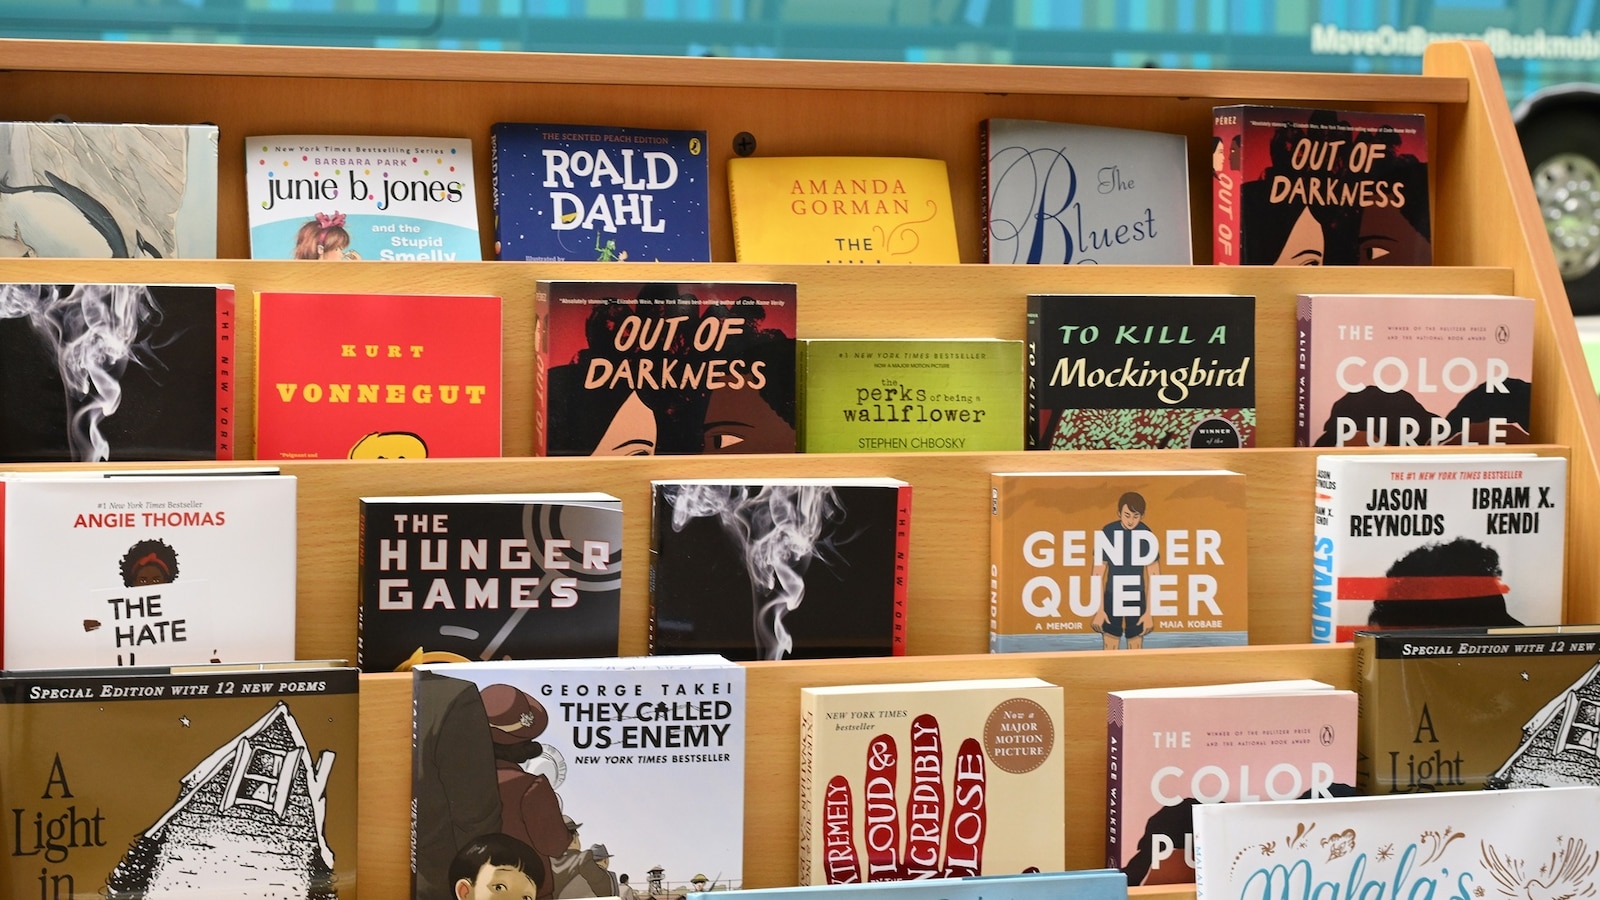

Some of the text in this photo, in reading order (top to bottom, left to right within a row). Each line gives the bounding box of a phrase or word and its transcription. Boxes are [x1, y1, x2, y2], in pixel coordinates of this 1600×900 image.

[1215, 116, 1237, 126] PÉREZ
[542, 132, 669, 145] THE SCENTED PEACH EDITION
[315, 158, 407, 167] BARBARA PARK
[356, 147, 410, 155] Bestselling
[1291, 138, 1386, 174] OUT OF
[542, 149, 679, 191] ROALD
[1097, 165, 1135, 194] The
[262, 171, 338, 210] junie
[790, 179, 907, 195] AMANDA
[1269, 175, 1406, 208] DARKNESS
[550, 192, 666, 233] DAHL
[791, 200, 909, 215] GORMAN
[990, 147, 1157, 264] Bluest
[1218, 173, 1233, 257] OUT OF
[372, 224, 420, 233] and the
[391, 237, 443, 249] Stupid
[834, 238, 873, 251] THE
[380, 249, 456, 261] Smelly
[614, 315, 746, 352] OUT OF
[1058, 325, 1227, 345] TO KILL A
[1338, 325, 1374, 341] THE
[341, 345, 424, 358] KURT
[1029, 342, 1036, 367] TO
[220, 310, 229, 451] THE NEW YORK
[584, 358, 767, 391] DARKNESS
[881, 379, 898, 387] the
[1049, 357, 1250, 405] Mockingbird
[1335, 356, 1511, 394] COLOR
[276, 383, 486, 404] VONNEGUT
[856, 384, 927, 405] perks
[930, 394, 942, 402] of
[943, 394, 973, 404] being
[843, 405, 986, 423] wallflower
[1337, 416, 1508, 447] PURPLE
[858, 438, 966, 449] STEPHEN CHBOSKY
[1391, 470, 1523, 480] THE #1 NEW YORK TIMES BESTSELLER
[97, 502, 107, 510] #1
[127, 501, 143, 509] York
[145, 501, 166, 509] Times
[167, 500, 203, 509] Bestseller
[1366, 488, 1428, 511] JASON
[1472, 486, 1555, 510] IBRAM X.
[73, 511, 226, 528] ANGIE THOMAS
[394, 514, 449, 534] THE
[1350, 514, 1445, 537] REYNOLDS
[1487, 512, 1539, 535] KENDI
[379, 539, 610, 571] HUNGER
[1022, 529, 1225, 569] GENDER
[895, 508, 906, 643] THE NEW YORK
[378, 577, 579, 611] GAMES
[1021, 574, 1224, 618] QUEER
[1312, 536, 1334, 644] STAMP
[107, 595, 162, 620] THE
[990, 564, 998, 643] GENDER
[115, 619, 187, 648] HATE
[1035, 621, 1083, 631] A MEMOIR
[1159, 620, 1223, 629] MAIA KOBABE
[1549, 641, 1565, 652] 12
[215, 681, 235, 695] 12
[540, 682, 732, 697] GEORGE TAKEI
[559, 700, 732, 723] THEY CALLED
[825, 710, 908, 720] NEW YORK TIMES
[1003, 710, 1025, 720] Now
[1413, 701, 1439, 744] A
[572, 723, 731, 749] US ENEMY
[835, 723, 875, 732] bestseller
[1000, 722, 1038, 733] MAJOR
[995, 734, 1043, 745] MOTION
[1153, 731, 1191, 748] THE
[575, 753, 730, 765] NEW YORK TIMES BESTSELLER
[868, 741, 896, 771] &
[994, 746, 1044, 757] PICTURE
[41, 752, 74, 799] A
[1388, 749, 1465, 792] Light
[1109, 736, 1118, 844] ALICE WALKER
[1150, 762, 1335, 807] COLOR
[907, 722, 941, 880] NCREDIBLY
[11, 806, 107, 864] Light
[827, 782, 858, 884] XTREMELY
[866, 776, 898, 874] LOUD
[38, 868, 74, 900] in
